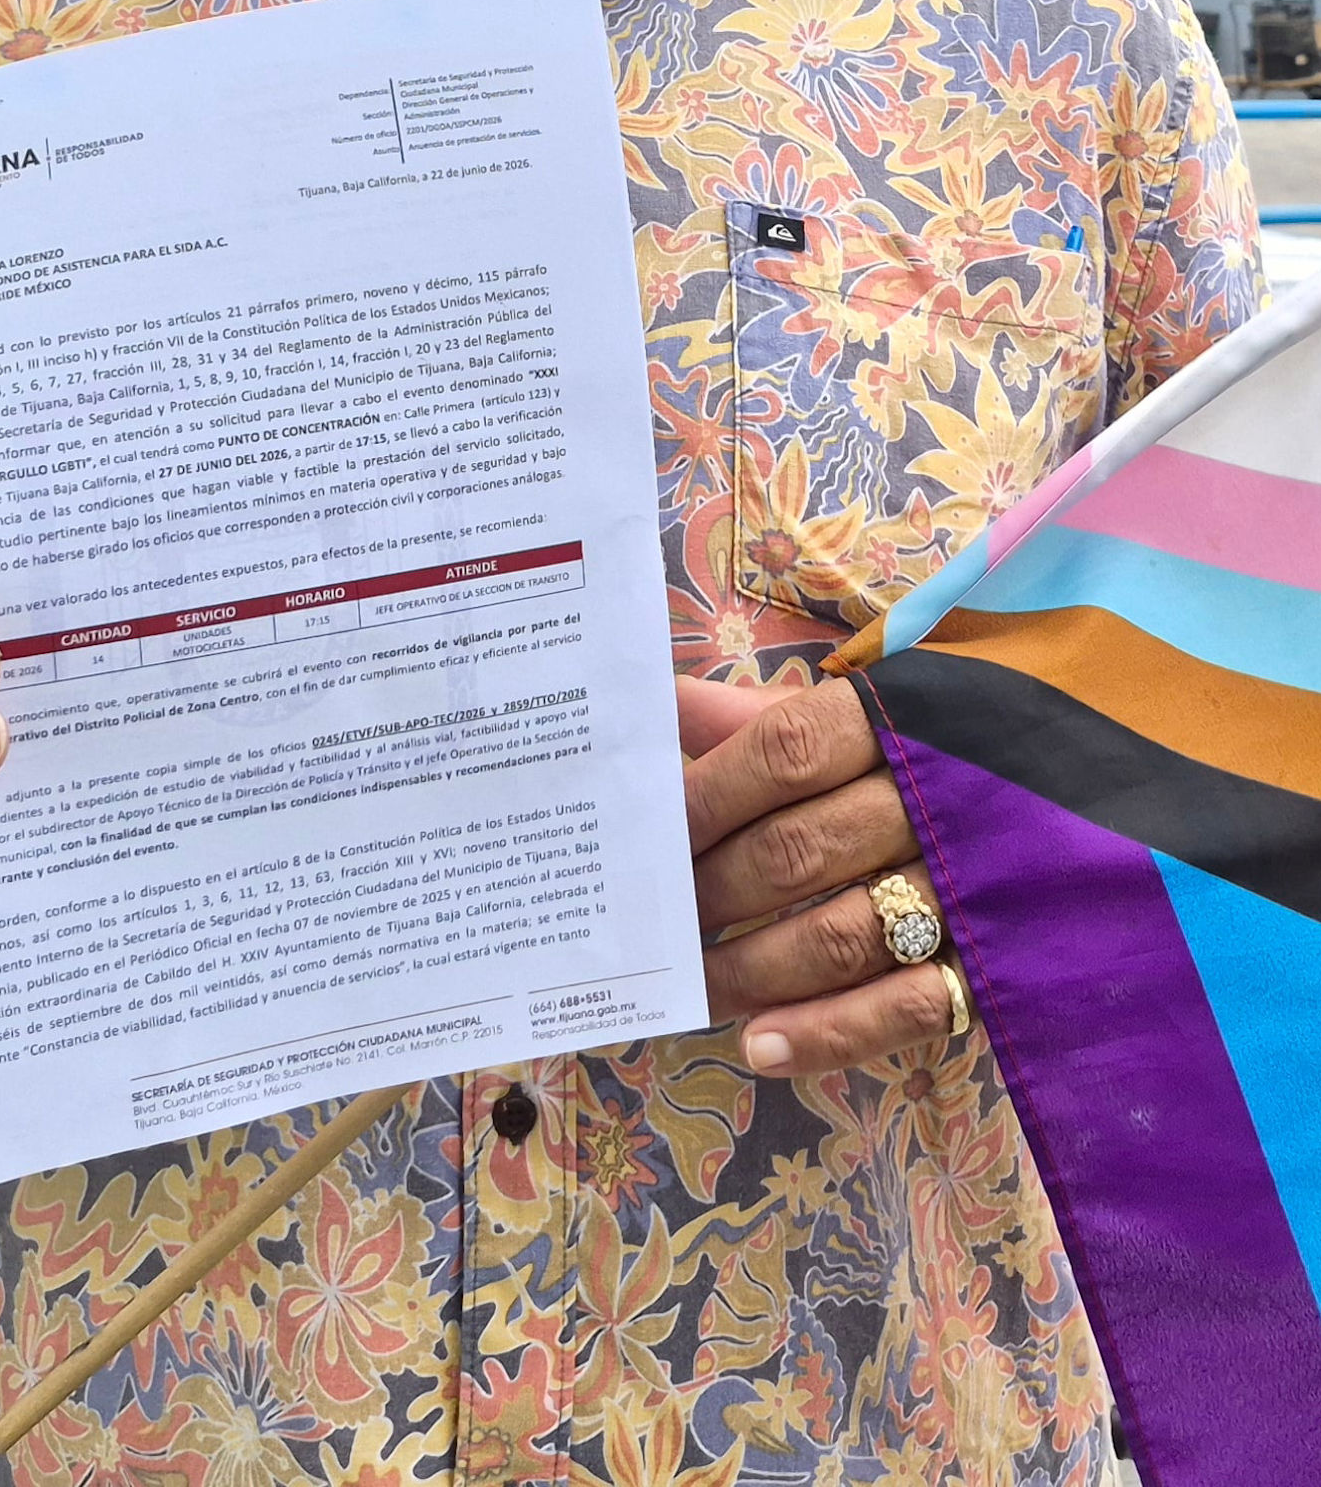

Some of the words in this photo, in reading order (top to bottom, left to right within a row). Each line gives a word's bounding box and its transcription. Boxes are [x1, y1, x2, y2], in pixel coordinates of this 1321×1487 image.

[437, 75, 448, 83] de
[469, 93, 480, 101] de
[54, 131, 144, 157] RESPONSABILIDAD
[55, 155, 69, 165] DE
[71, 147, 106, 162] TODOS
[297, 185, 341, 199] Tijuana,
[342, 180, 366, 193] Baja
[367, 173, 420, 189] California,
[422, 173, 429, 182] a
[430, 169, 444, 181] 22
[445, 167, 459, 179] de
[461, 164, 488, 179] junio
[489, 162, 503, 173] de
[504, 158, 533, 171] 2026.
[9, 248, 65, 268] LORENZO
[33, 266, 50, 279] DE
[52, 253, 122, 275] ASISTENCIA
[123, 247, 157, 263] PARA
[158, 245, 173, 257] EL
[173, 240, 203, 255] SIDA
[204, 236, 229, 250] A.C.
[23, 278, 72, 296] MÉXICO
[99, 454, 111, 467] el
[113, 449, 138, 464] cual
[140, 443, 180, 460] tendrá
[182, 441, 215, 454] como
[217, 432, 261, 448] PUNTO
[262, 428, 279, 441] DE
[281, 411, 381, 438] CONCENTRACIÓN
[383, 412, 401, 423] en:
[403, 405, 430, 419] Calle
[432, 400, 475, 415] Primera
[480, 391, 526, 409] (artículo
[528, 386, 552, 401] 123)
[553, 387, 561, 398] y
[445, 560, 498, 580] ATIENDE
[285, 587, 345, 608] HORARIO
[375, 604, 394, 615] JEFE
[396, 594, 447, 611] OPERATIVO
[448, 591, 461, 602] DE
[462, 590, 474, 600] LA
[475, 582, 513, 597] SECCION
[514, 580, 526, 590] DE
[527, 571, 570, 588] TRANSITO
[176, 606, 236, 627] SERVICIO
[61, 624, 132, 646] CANTIDAD
[183, 626, 232, 643] UNIDADES
[172, 636, 246, 658] MOTOCICLETAS
[92, 655, 105, 665] 14
[2, 669, 16, 680] DE
[18, 664, 43, 677] 2026
[5, 786, 53, 803] adjunto
[58, 784, 66, 794] a
[71, 780, 82, 791] la
[88, 770, 141, 790] presente
[145, 763, 178, 778] copia
[183, 755, 222, 771] simple
[226, 752, 242, 764] de
[247, 748, 265, 760] los
[269, 741, 307, 756] oficios
[490, 706, 499, 718] y
[45, 896, 107, 919] conforme
[111, 894, 120, 904] a
[123, 889, 136, 901] lo
[139, 877, 201, 898] dispuesto
[205, 873, 222, 885] en
[225, 867, 237, 881] el
[241, 859, 289, 878] artículo
[292, 855, 301, 867] 8
[304, 852, 321, 865] de
[324, 849, 336, 861] la
[339, 834, 416, 858] Constitución
[419, 826, 462, 842] Política
[466, 821, 482, 834] de
[485, 818, 503, 830] los
[507, 808, 552, 826] Estados
[555, 800, 596, 816] Unidos
[531, 1017, 617, 1040] Responsabilidad
[619, 1016, 634, 1026] de
[635, 1010, 666, 1022] Todos
[131, 1078, 195, 1103] SECRETARÍA
[197, 1074, 211, 1088] DE
[213, 1059, 275, 1083] SEGURIDAD
[277, 1056, 285, 1067] Y
[286, 1040, 356, 1065] PROTECCIÓN
[357, 1027, 424, 1049] CIUDADANA
[425, 1015, 483, 1035] MUNICIPAL
[179, 1106, 204, 1120] Baja
